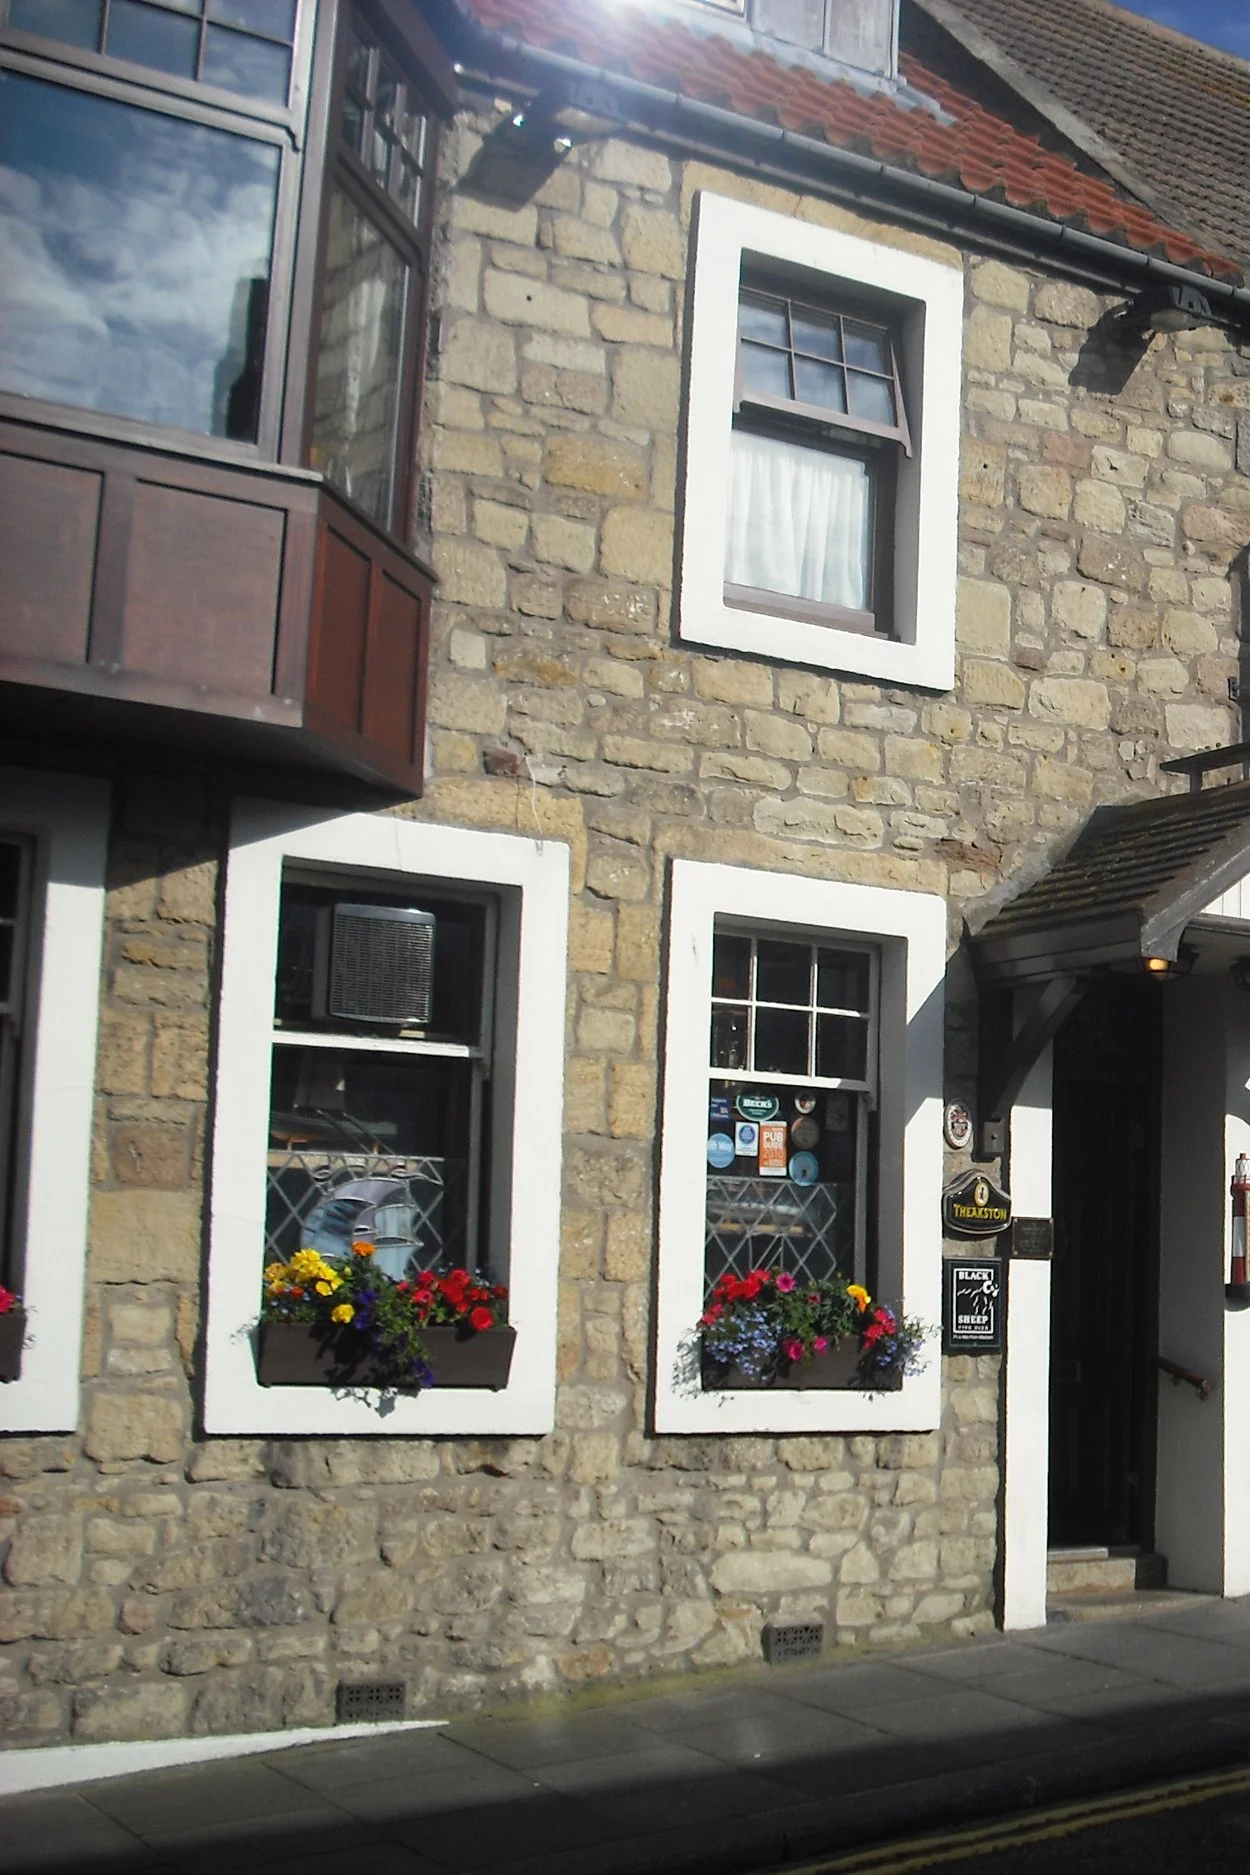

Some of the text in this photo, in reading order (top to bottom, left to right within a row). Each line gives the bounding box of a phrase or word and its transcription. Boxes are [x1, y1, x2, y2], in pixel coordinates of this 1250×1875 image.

[763, 1132, 784, 1142] PUB
[953, 1203, 1007, 1220] THEAKSTON
[958, 1271, 989, 1280] BLACK
[958, 1315, 989, 1324] SHEEP
